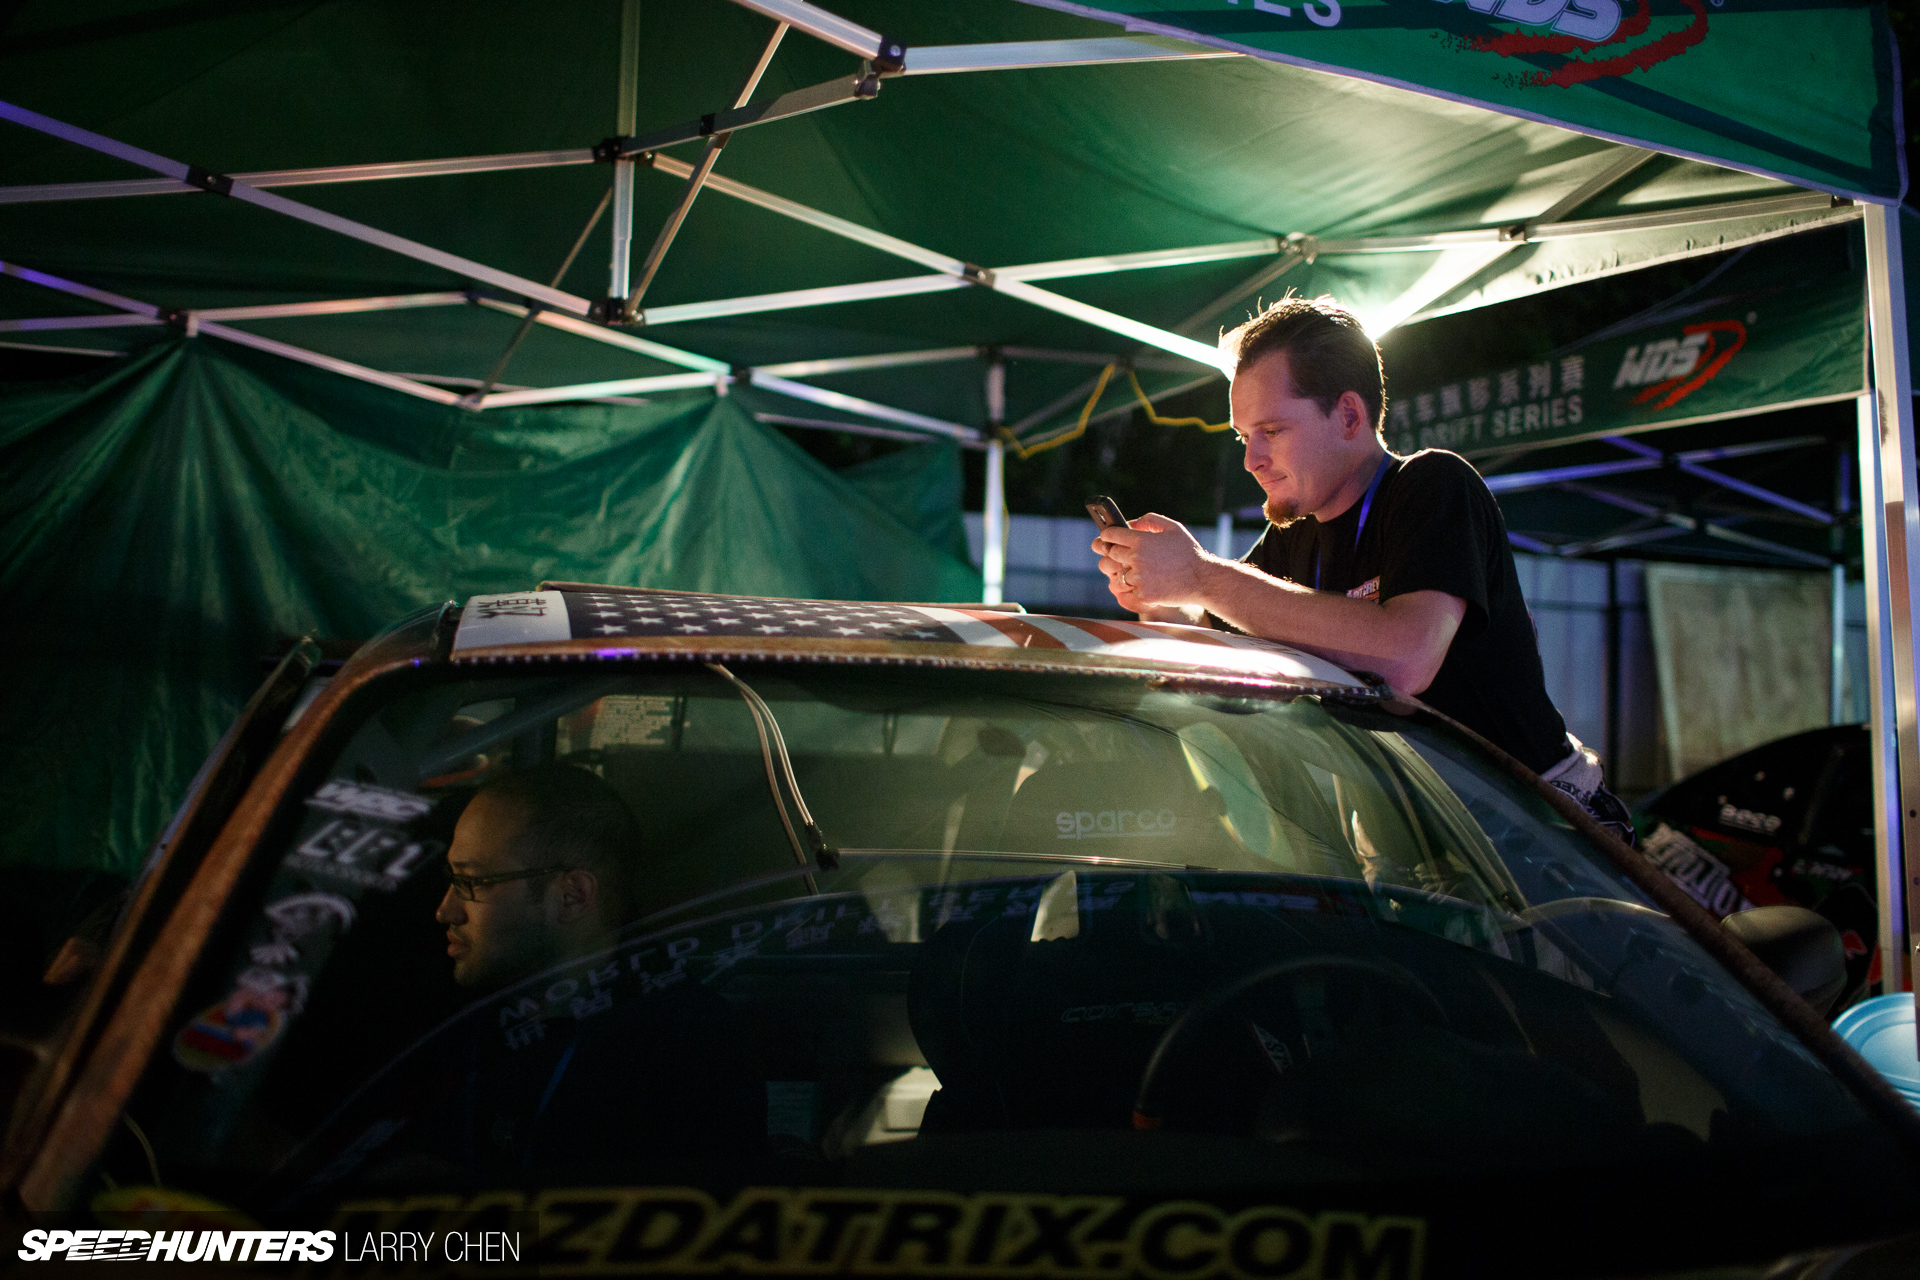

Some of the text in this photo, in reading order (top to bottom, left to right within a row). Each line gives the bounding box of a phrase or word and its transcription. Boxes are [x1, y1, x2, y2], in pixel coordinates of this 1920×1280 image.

[1613, 331, 1710, 390] WDS
[1492, 394, 1584, 438] SERIES
[1055, 808, 1178, 840] sparco
